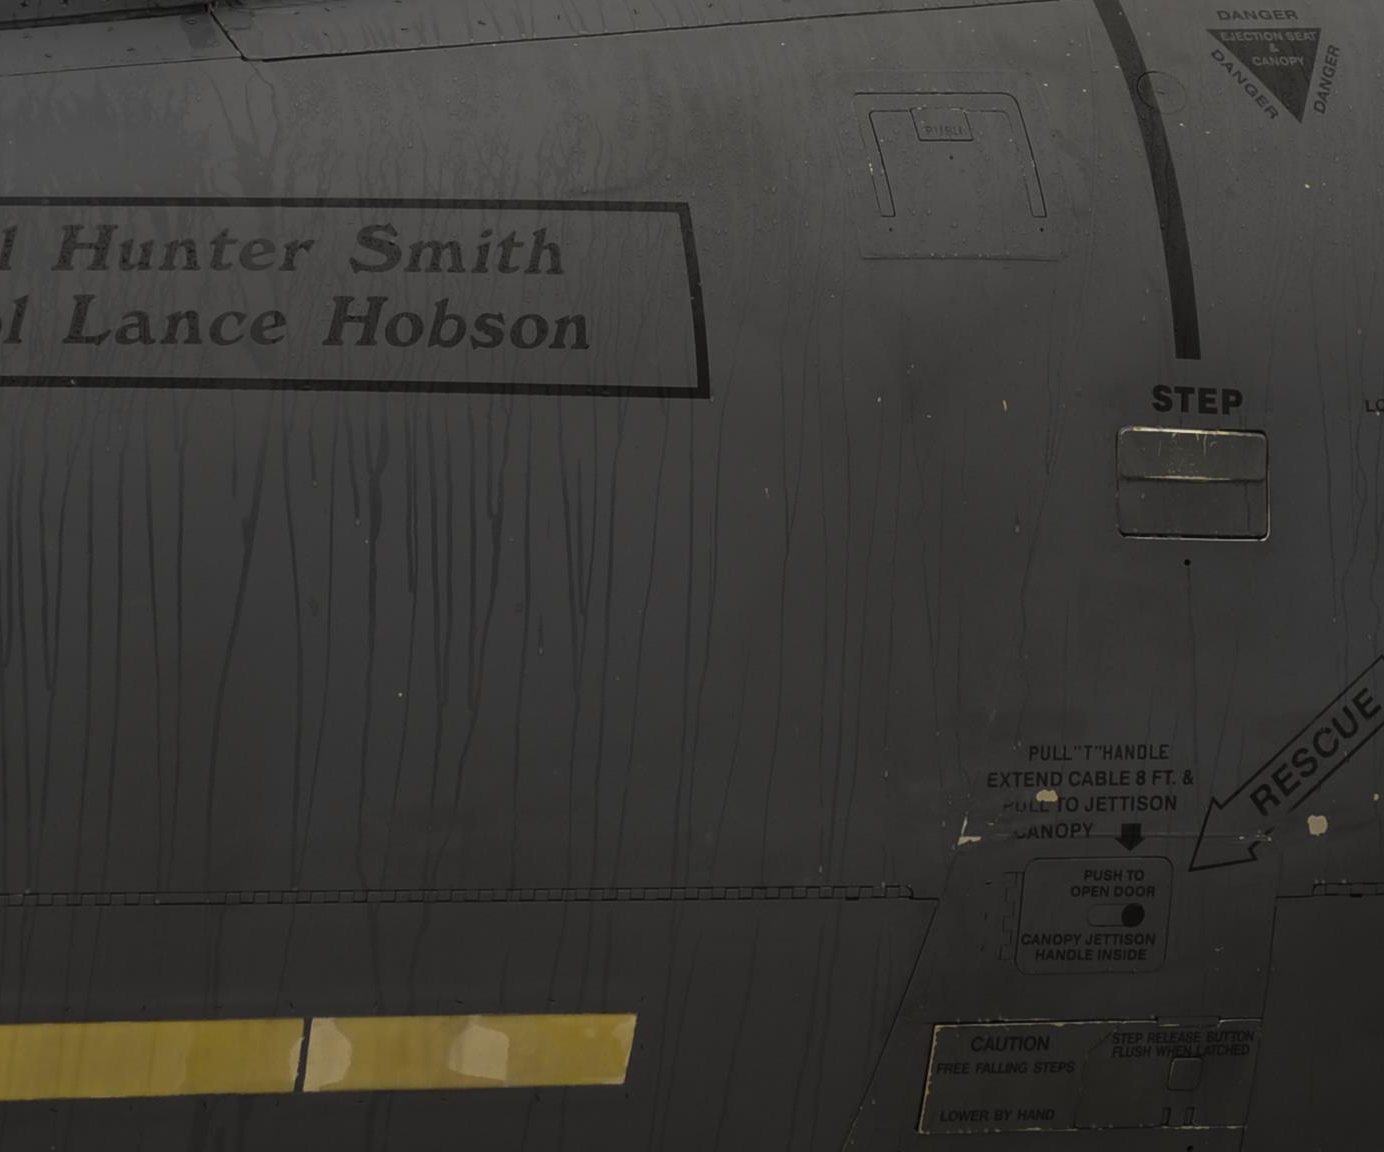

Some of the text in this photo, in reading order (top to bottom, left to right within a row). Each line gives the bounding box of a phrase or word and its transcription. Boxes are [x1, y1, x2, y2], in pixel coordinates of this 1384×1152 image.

[1217, 9, 1299, 21] DANGER
[1221, 31, 1316, 41] EJECTION SEAT
[1252, 56, 1304, 66] CANOPY
[1210, 49, 1279, 120] DANGER
[1312, 44, 1341, 114] DANGER
[50, 223, 315, 273] Hunter
[348, 222, 566, 276] Smith
[61, 293, 287, 346] Lance
[321, 295, 591, 350] Hobson
[1151, 384, 1244, 416] STEP
[1028, 745, 1073, 762] PULL
[1102, 744, 1170, 760] HANDLE
[1249, 687, 1382, 816] RESCUE
[986, 769, 1194, 788] EXTEND CABLE 8 FT. &
[1055, 796, 1079, 812] TO
[1084, 795, 1177, 812] JETTISON
[1083, 869, 1145, 881] PUSH TO
[1070, 885, 1156, 898] OPEN DOOR
[1021, 933, 1156, 946] CANOPY JETTISON
[1035, 949, 1147, 961] HANDLE INSIDE
[970, 1035, 1050, 1052] CAUTION
[1112, 1031, 1255, 1045] STEP RELEASE BUTTON
[1111, 1043, 1251, 1058] FLUSH WHEN LATCHED
[936, 1061, 1076, 1075] FREE FALLING STEPS
[939, 1108, 1055, 1123] LOWER BY HAND
